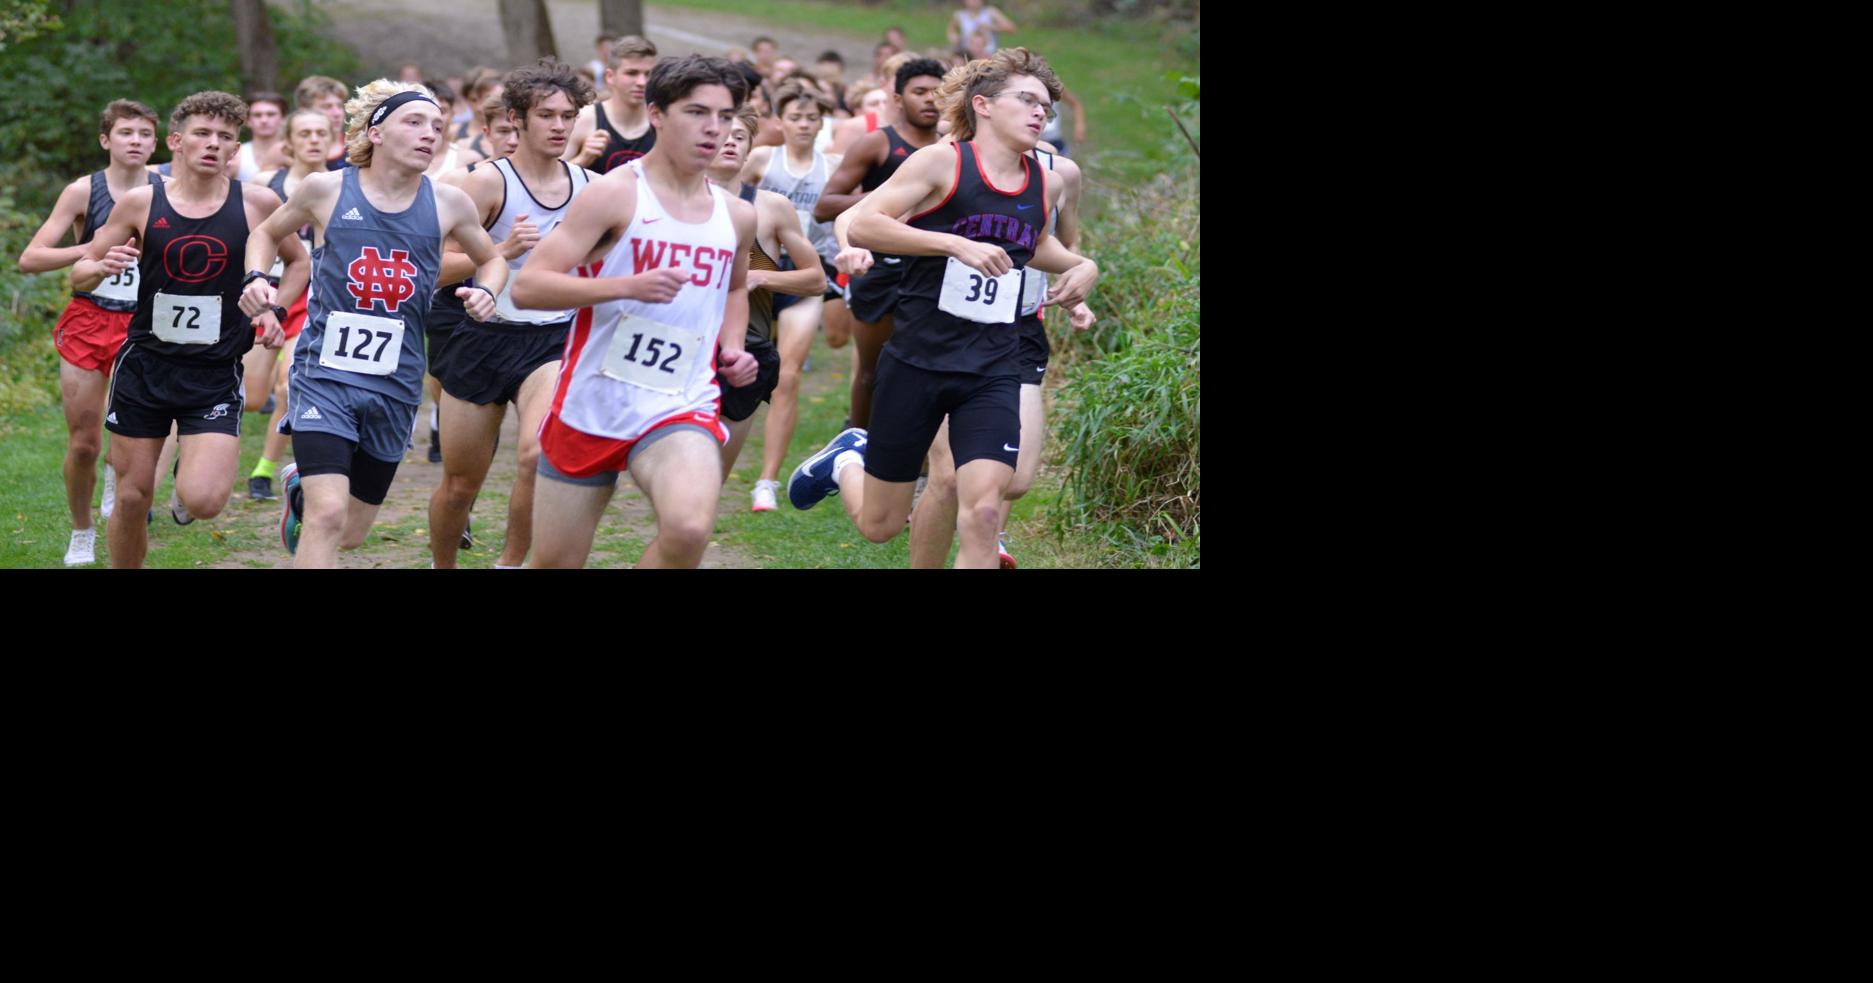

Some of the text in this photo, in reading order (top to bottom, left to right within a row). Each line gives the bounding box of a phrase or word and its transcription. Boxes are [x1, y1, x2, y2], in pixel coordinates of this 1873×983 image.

[163, 234, 228, 283] C
[630, 238, 734, 290] WEST
[965, 273, 999, 305] 39
[172, 305, 201, 329] 72
[334, 326, 393, 362] 127
[623, 332, 683, 374] 152
